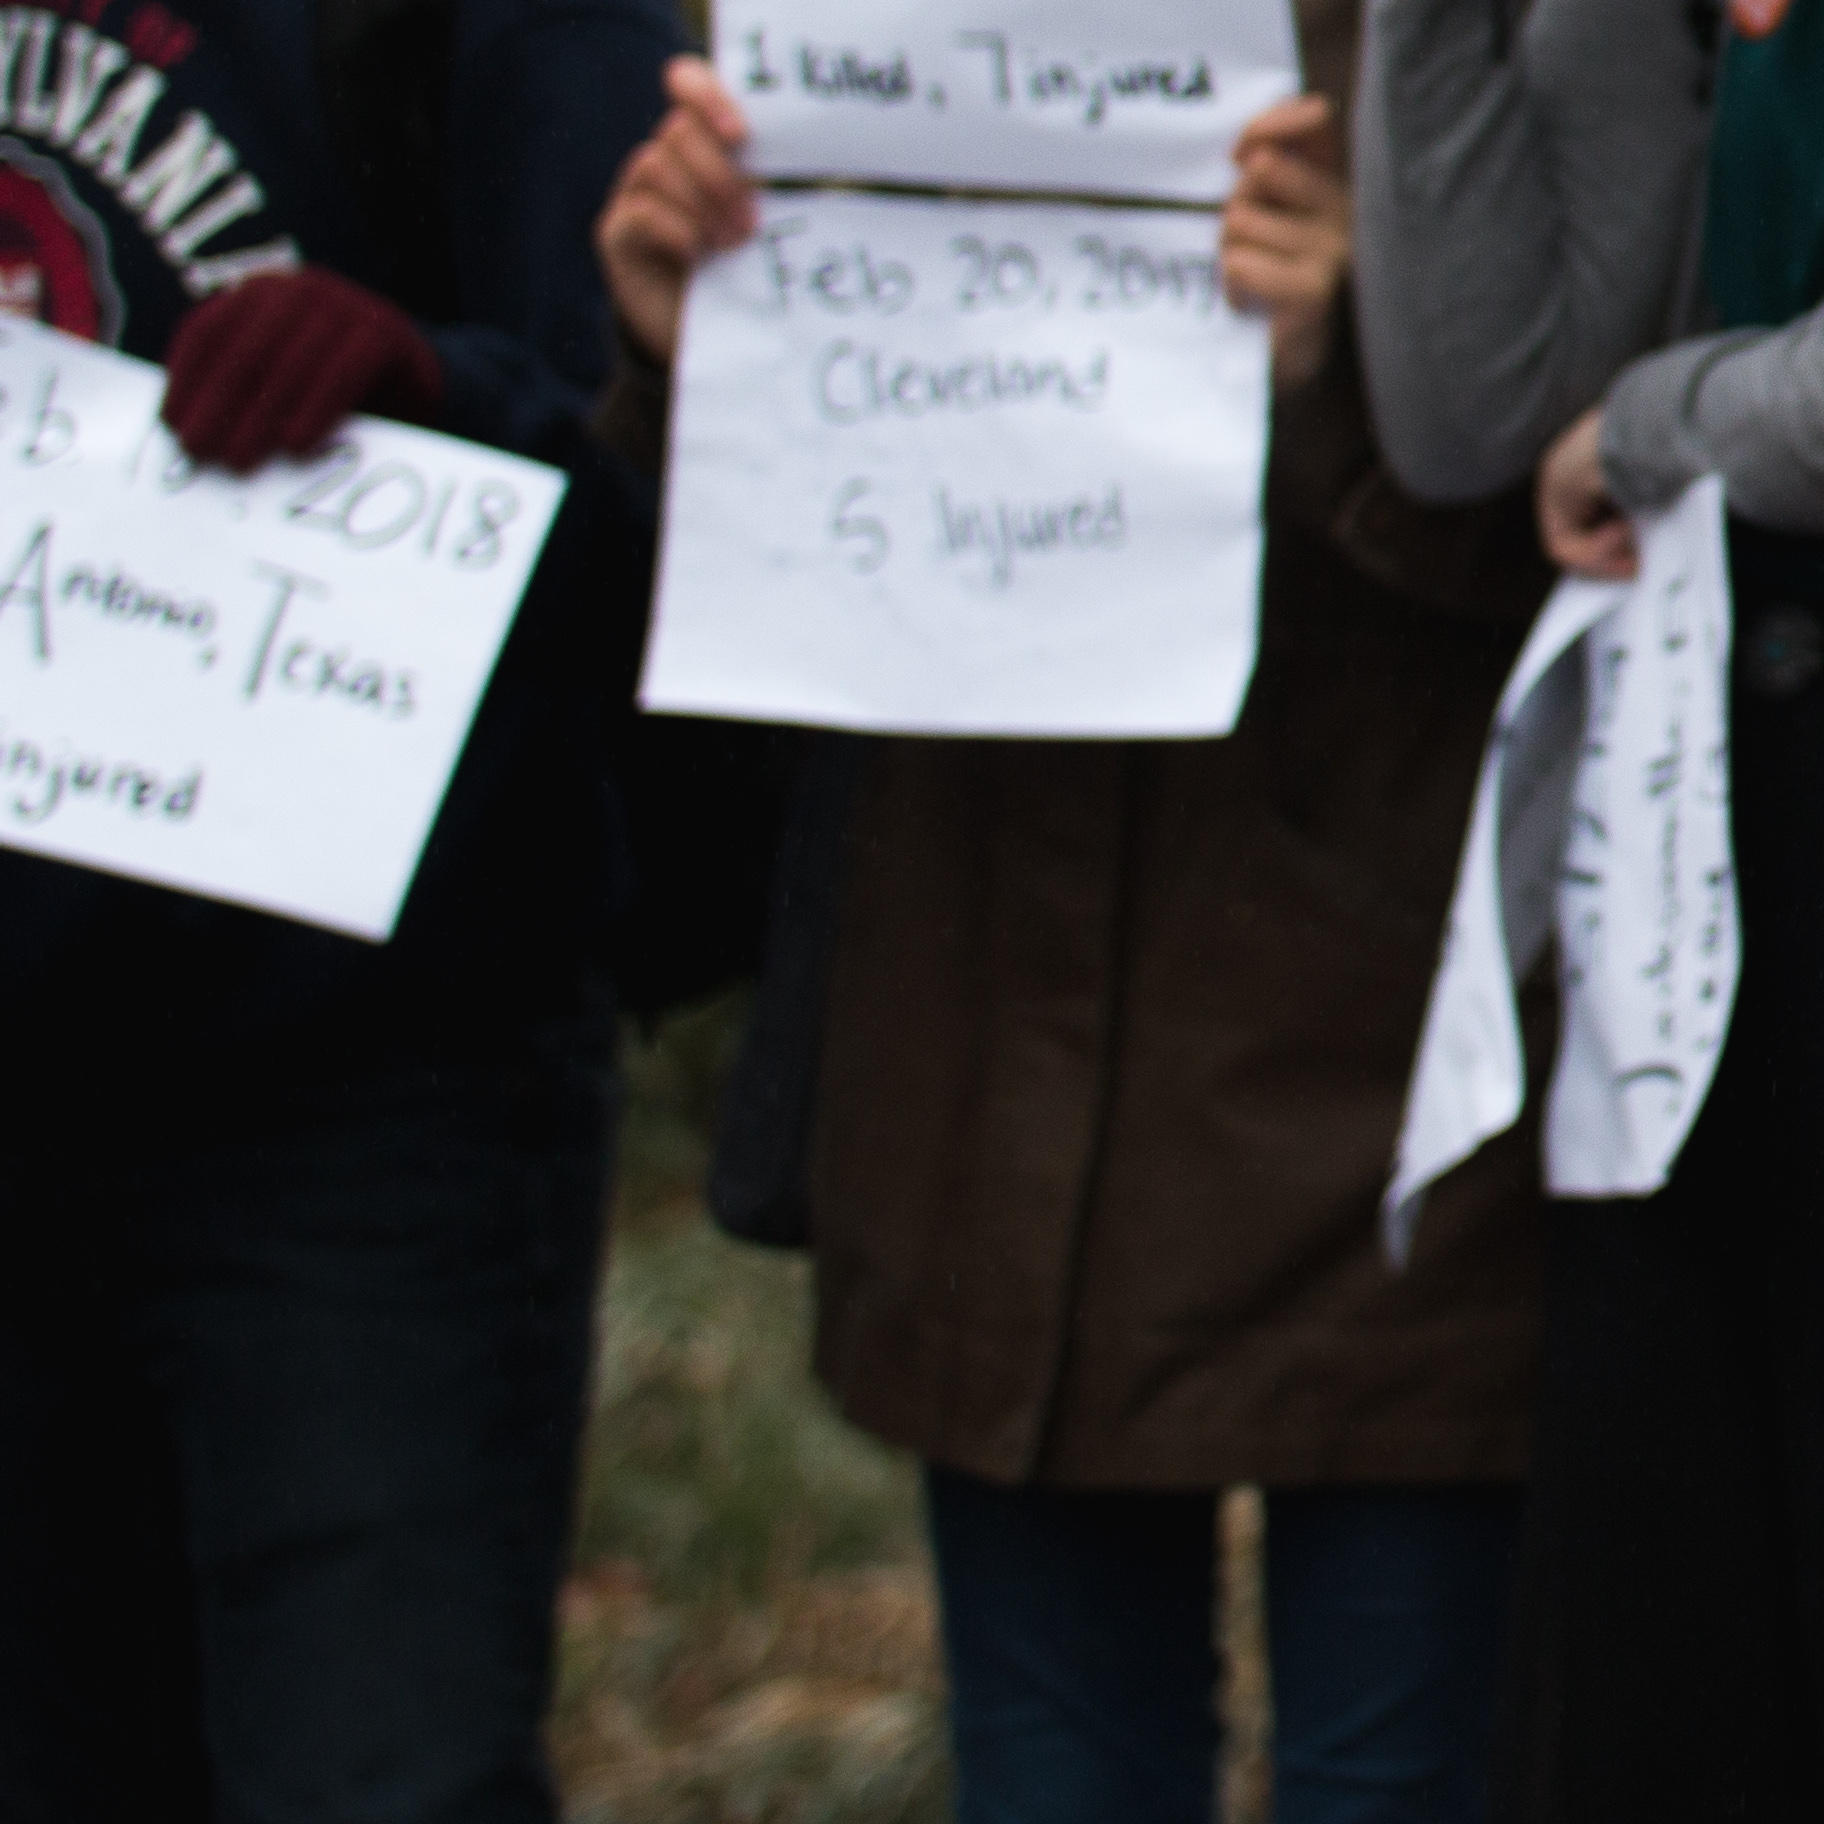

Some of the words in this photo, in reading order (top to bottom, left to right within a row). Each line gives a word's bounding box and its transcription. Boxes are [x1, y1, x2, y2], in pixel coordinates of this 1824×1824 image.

[957, 27, 1014, 104] 7
[1025, 51, 1217, 125] injured
[747, 214, 917, 317] Feb
[812, 334, 1112, 426] Cleveland
[287, 438, 522, 571] 2018
[829, 476, 892, 576] 5
[930, 479, 1133, 594] Injured
[243, 556, 420, 719] Texas
